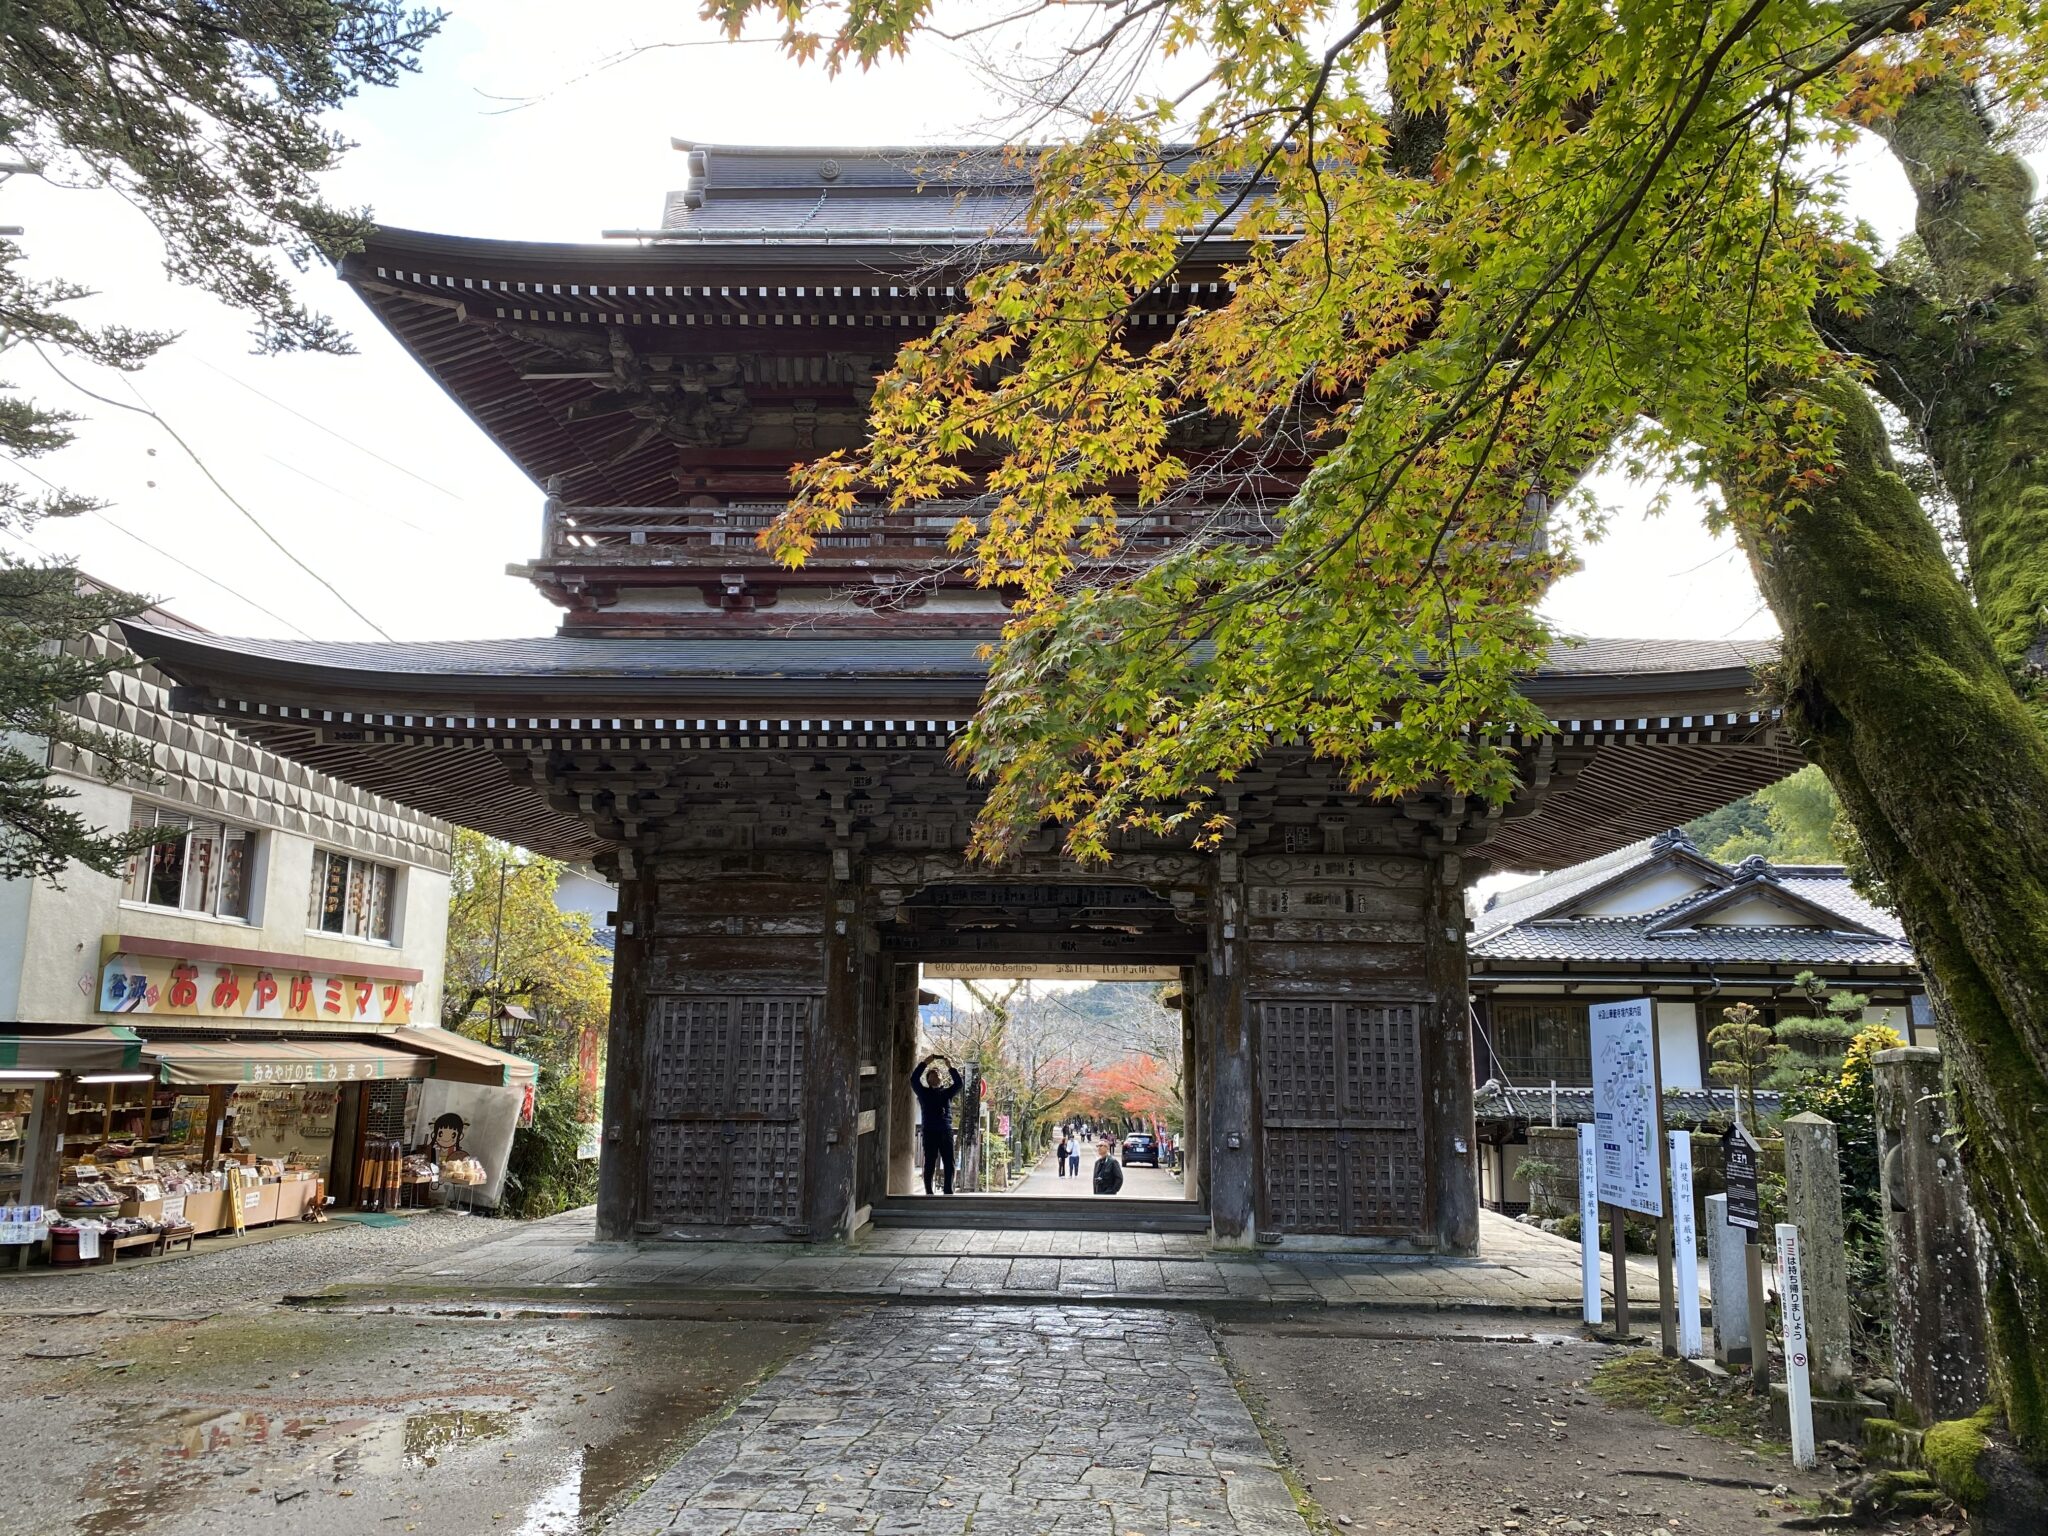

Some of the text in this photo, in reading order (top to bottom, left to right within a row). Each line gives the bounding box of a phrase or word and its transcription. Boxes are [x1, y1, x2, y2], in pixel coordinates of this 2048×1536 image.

[110, 964, 400, 1016] 谷汲 おみやげミマツ
[254, 1063, 374, 1081] おみやげの店 みまつ
[1585, 1148, 1595, 1184] 揖斐川町
[1731, 1152, 1748, 1165] 仁王門
[1680, 1162, 1690, 1203] 揖斐川町
[1786, 1238, 1803, 1341] ゴミは持ち帰りましょう
